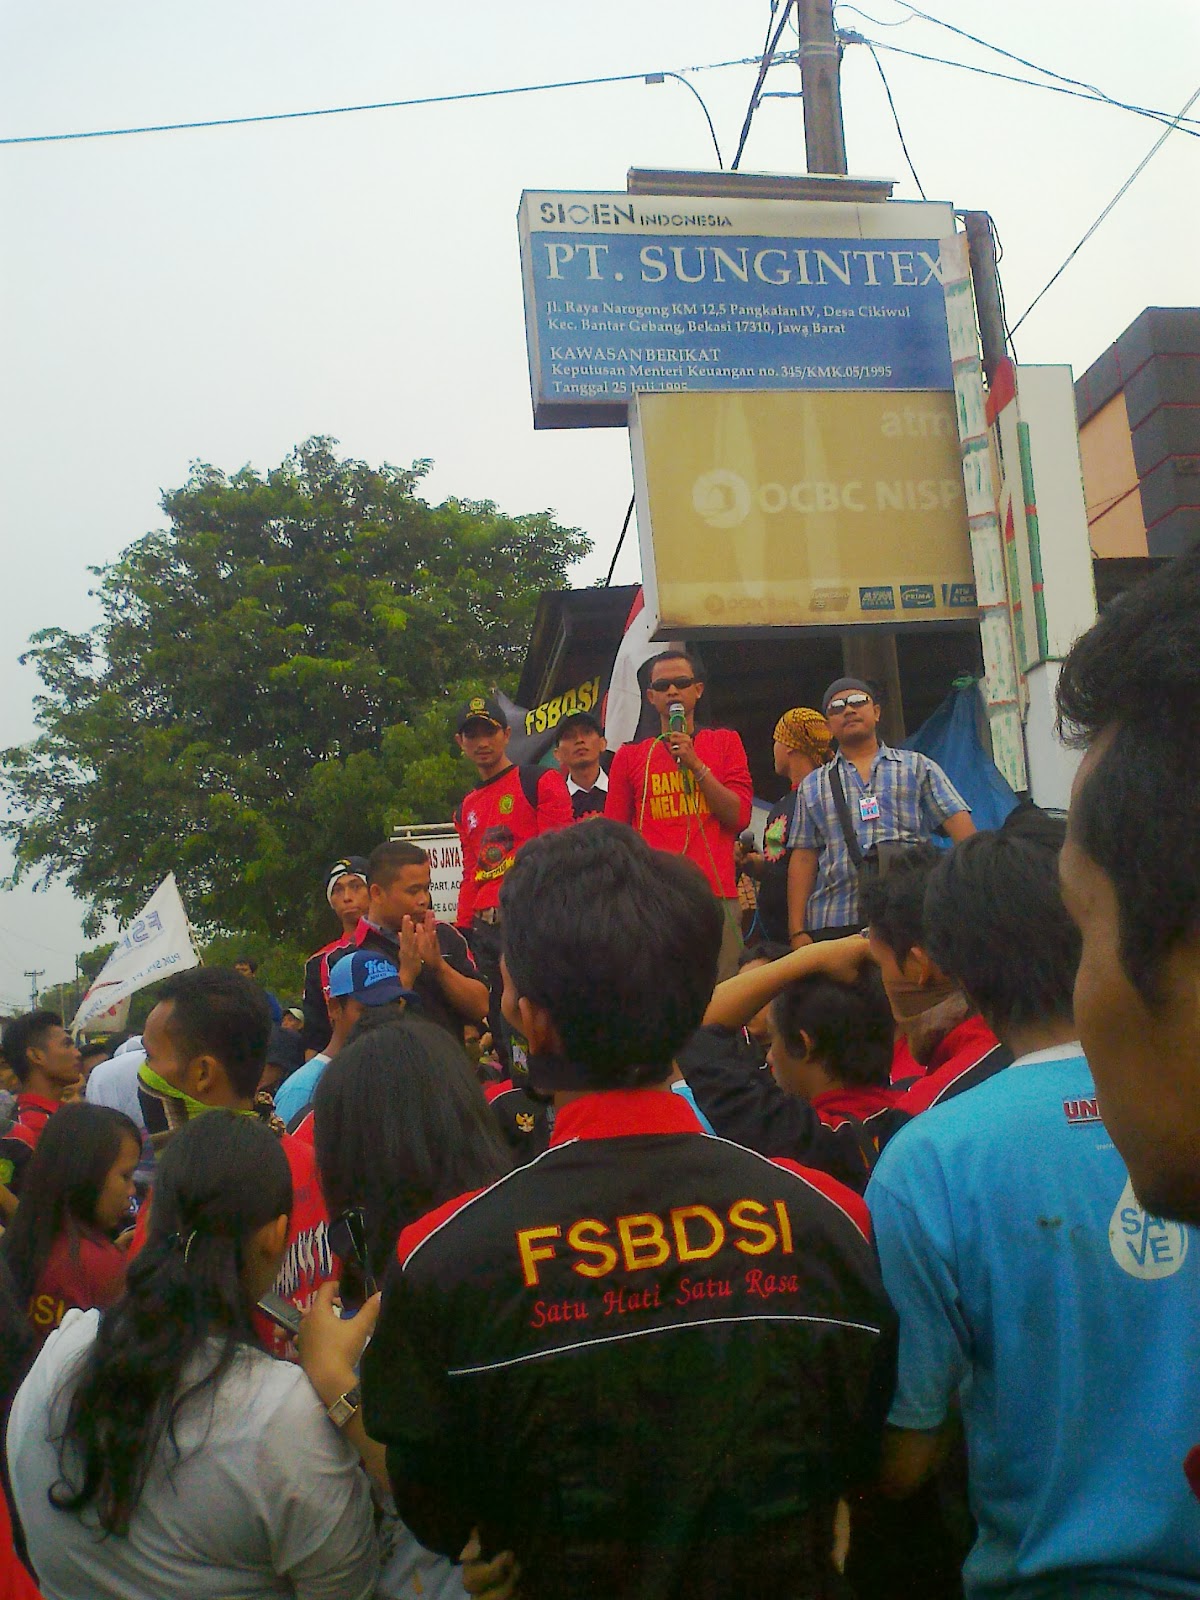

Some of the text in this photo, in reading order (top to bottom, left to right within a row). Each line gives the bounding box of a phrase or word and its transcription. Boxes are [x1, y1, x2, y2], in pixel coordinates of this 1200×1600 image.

[540, 202, 733, 227] SIOEN INDONESIA
[544, 242, 944, 287] PT. SUNGINTEX
[546, 301, 911, 319] Jl. Raya Narogong KM 12,5 Pangkalan IV, Desa Cikiwul
[548, 319, 846, 336] Kec. Bantar Gebang, Bekasi 17310, Jawa Barat
[550, 346, 721, 362] KAWASAN BERIKAT
[551, 363, 892, 381] Keputusan Menteri Keuangan no. 345/KMK.05/1995
[552, 381, 608, 397] Tanggal
[612, 381, 627, 394] 25
[880, 406, 954, 438] atm
[759, 479, 961, 514] OCBC NISP
[650, 791, 711, 820] MELAWA
[440, 847, 461, 868] JAYA
[1063, 1098, 1100, 1119] UN
[515, 1199, 795, 1288] FSBDSI
[530, 1269, 799, 1328] Satu Hati Satu Rasa
